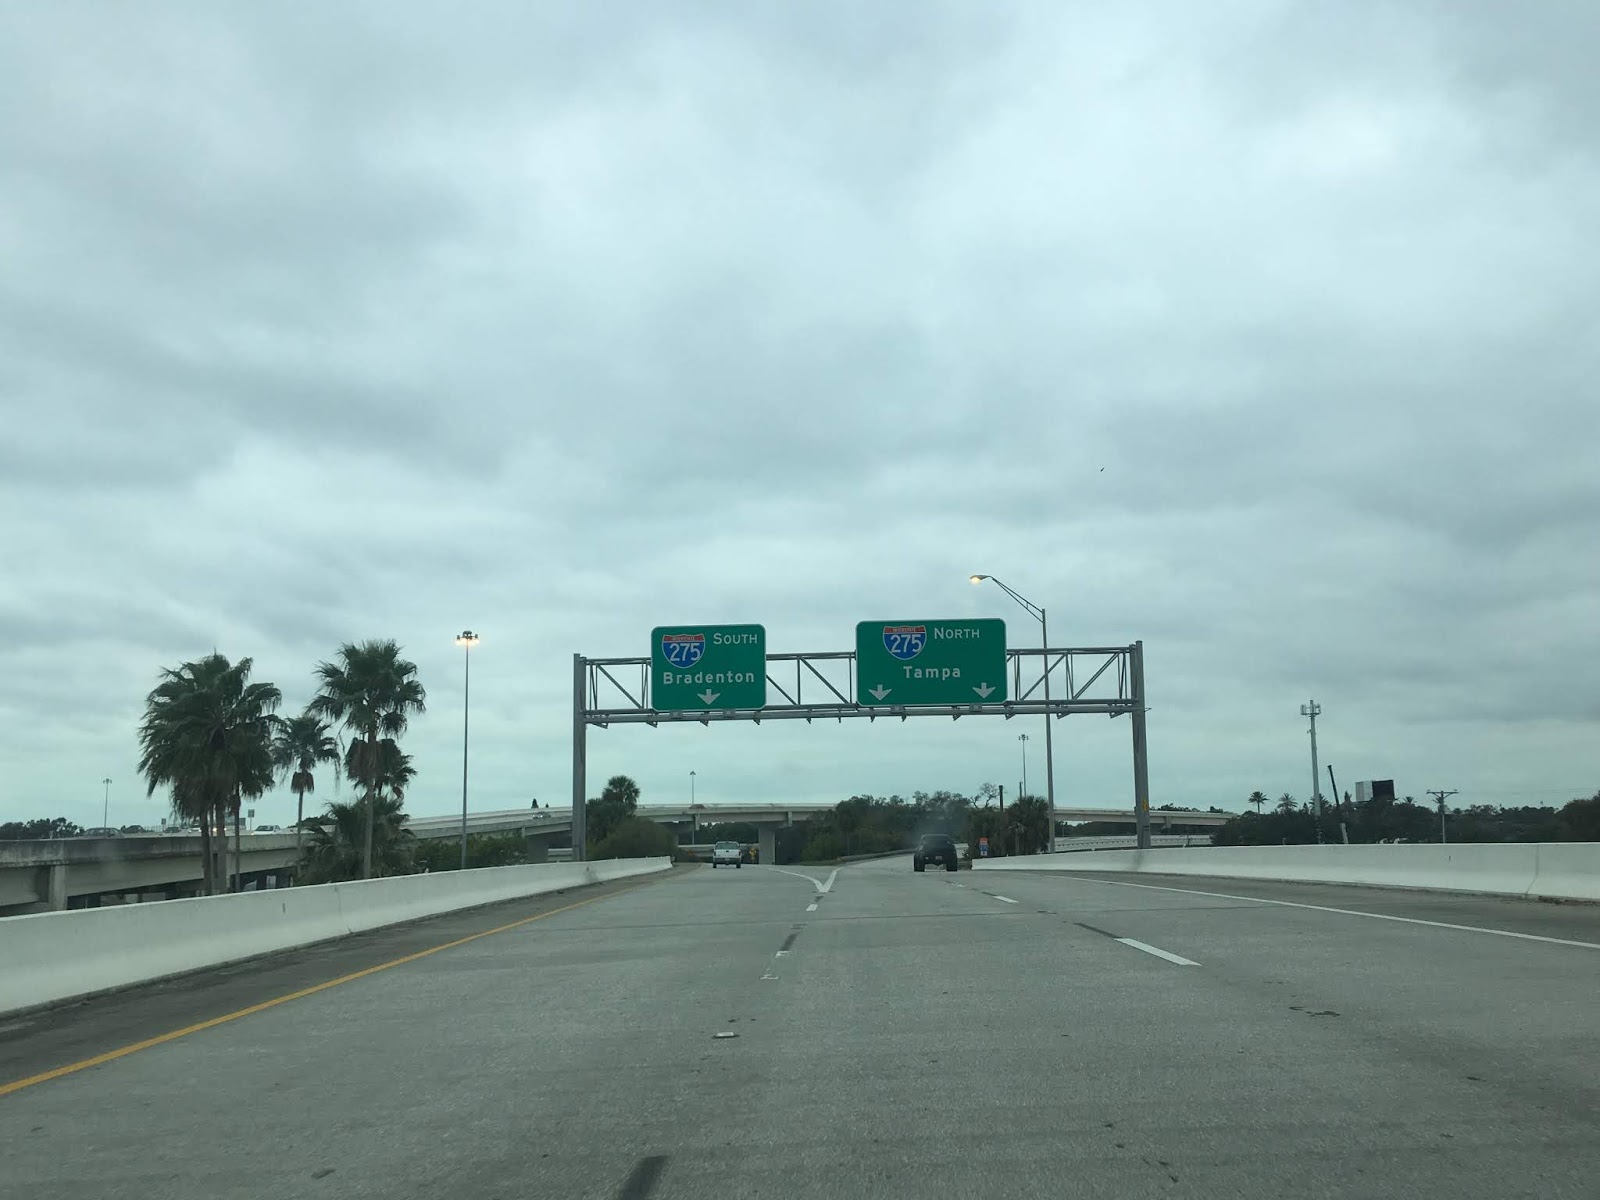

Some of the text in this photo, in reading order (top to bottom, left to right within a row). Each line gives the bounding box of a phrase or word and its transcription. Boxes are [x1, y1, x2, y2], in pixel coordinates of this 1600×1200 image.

[713, 633, 758, 645] SOUTH
[934, 627, 980, 639] NORTH
[890, 634, 922, 653] 275
[669, 643, 701, 661] 275
[663, 671, 755, 685] Bradenton
[903, 666, 961, 680] Tampa
